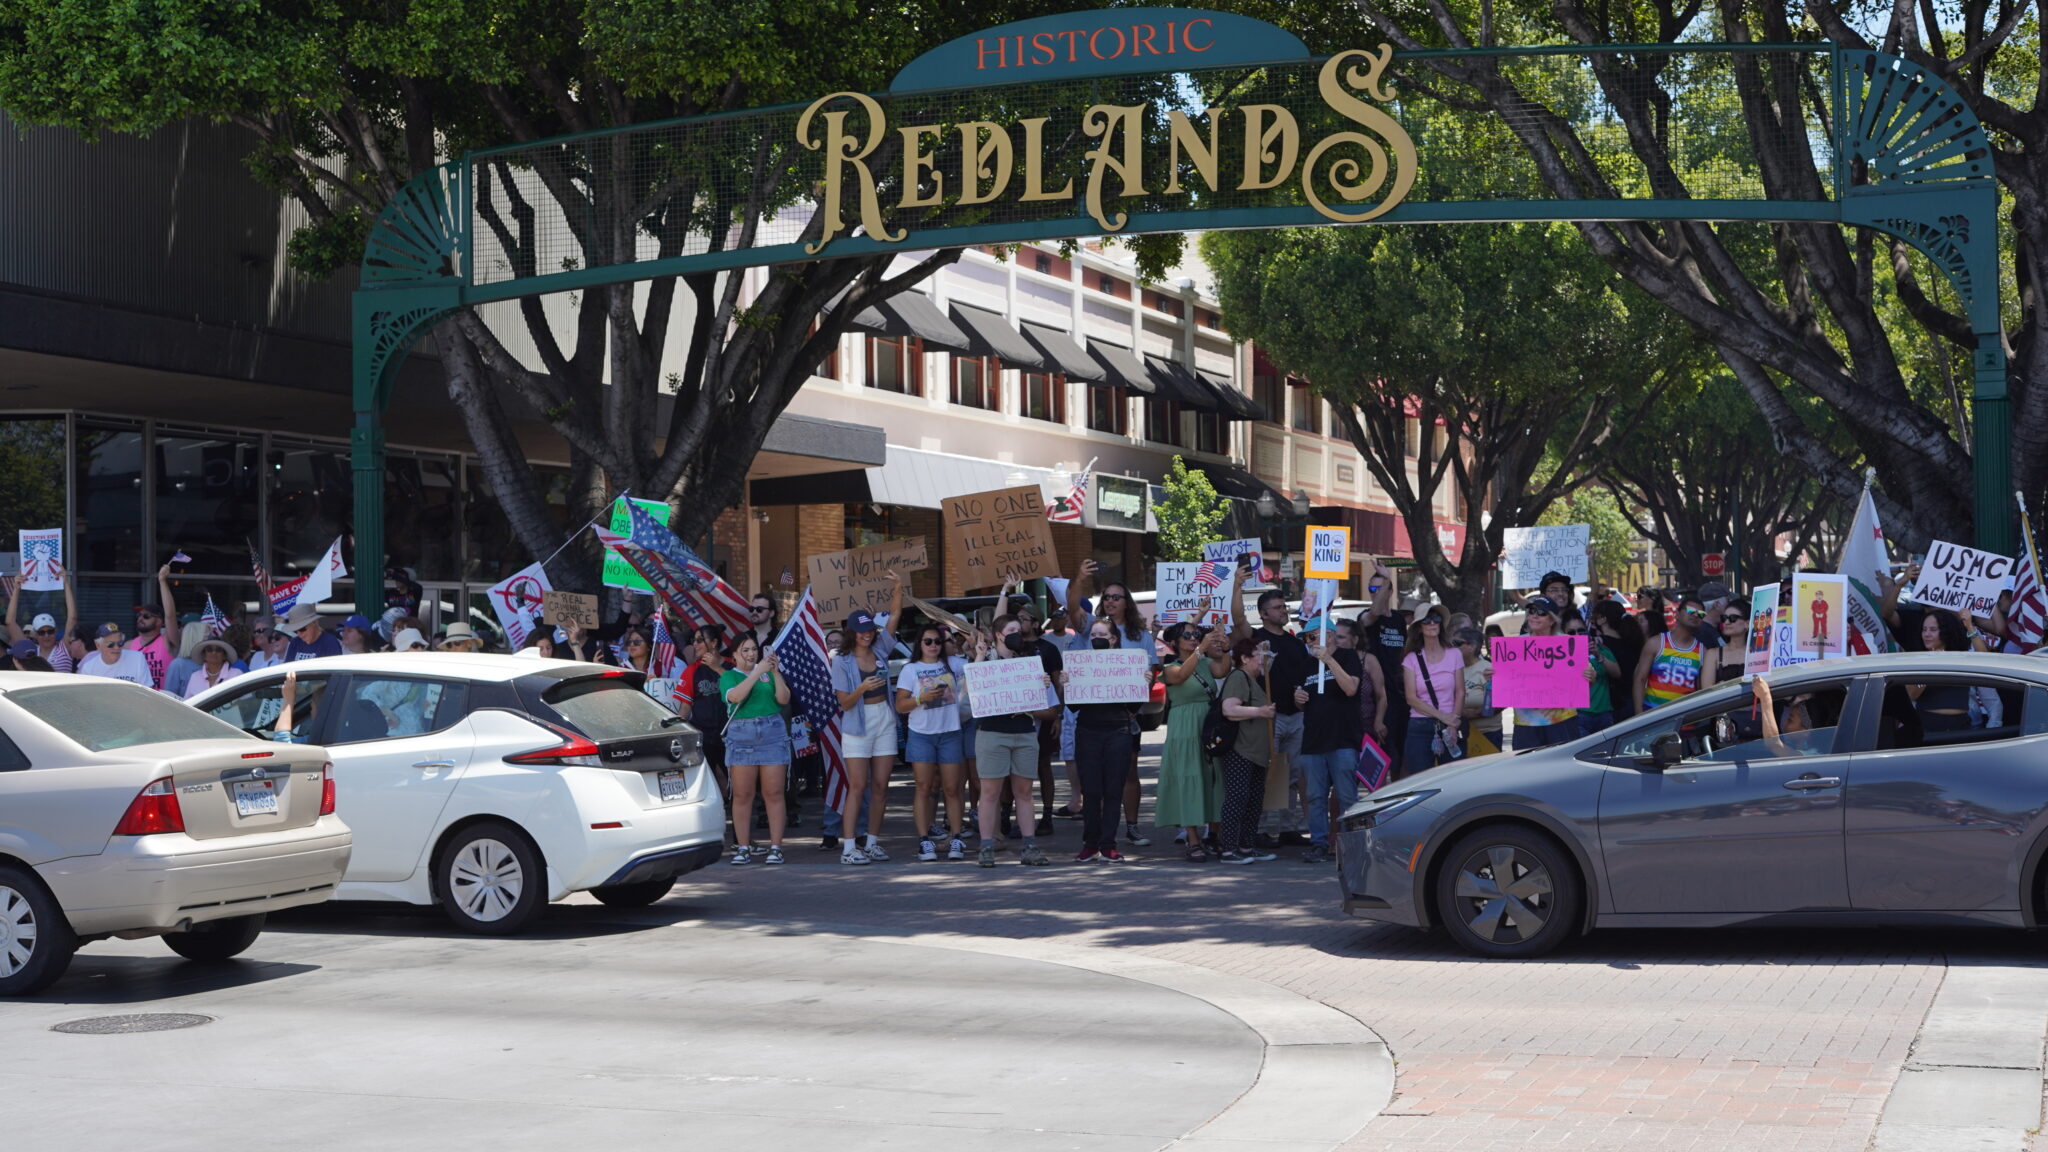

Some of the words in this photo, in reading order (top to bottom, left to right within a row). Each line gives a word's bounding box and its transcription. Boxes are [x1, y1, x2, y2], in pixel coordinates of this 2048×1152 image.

[976, 18, 1215, 71] HISTORIC
[796, 43, 1419, 255] REDLANDS
[953, 499, 983, 518] NO
[993, 492, 1040, 514] ONE
[989, 519, 1006, 533] IS
[1543, 529, 1557, 539] TO
[1559, 527, 1580, 538] THE
[964, 530, 1035, 551] ILLEGAL
[1315, 533, 1330, 547] NO
[967, 555, 986, 567] ON
[994, 541, 1047, 564] STOLEN
[1207, 540, 1253, 558] Worst
[1314, 548, 1341, 562] KING
[996, 560, 1039, 579] LAND
[1553, 556, 1564, 567] TO
[1565, 555, 1585, 566] THE
[1703, 560, 1724, 570] STOP
[1932, 543, 2008, 580] USMC
[605, 565, 621, 576] NO
[1176, 583, 1196, 595] FOR
[1945, 572, 1975, 590] VET
[270, 589, 290, 601] SAVE
[291, 582, 305, 593] OU
[561, 594, 587, 605] REAL
[1915, 584, 1967, 607] AGAINST
[816, 597, 840, 614] NOT
[849, 594, 859, 609] A
[1165, 596, 1226, 610] COMMUITY
[1095, 653, 1103, 664] IS
[1105, 653, 1124, 665] HERE
[1495, 641, 1517, 662] No
[1523, 637, 1576, 669] Kings!
[1670, 656, 1692, 666] PROUD
[967, 664, 997, 679] TRUMP
[1000, 662, 1025, 673] WANTS
[1067, 666, 1086, 678] ARE
[1090, 667, 1107, 678] YOU
[1657, 662, 1699, 689] 365
[1000, 690, 1023, 706] FALL
[1065, 684, 1088, 701] FUCK
[1105, 684, 1127, 700] FUCK
